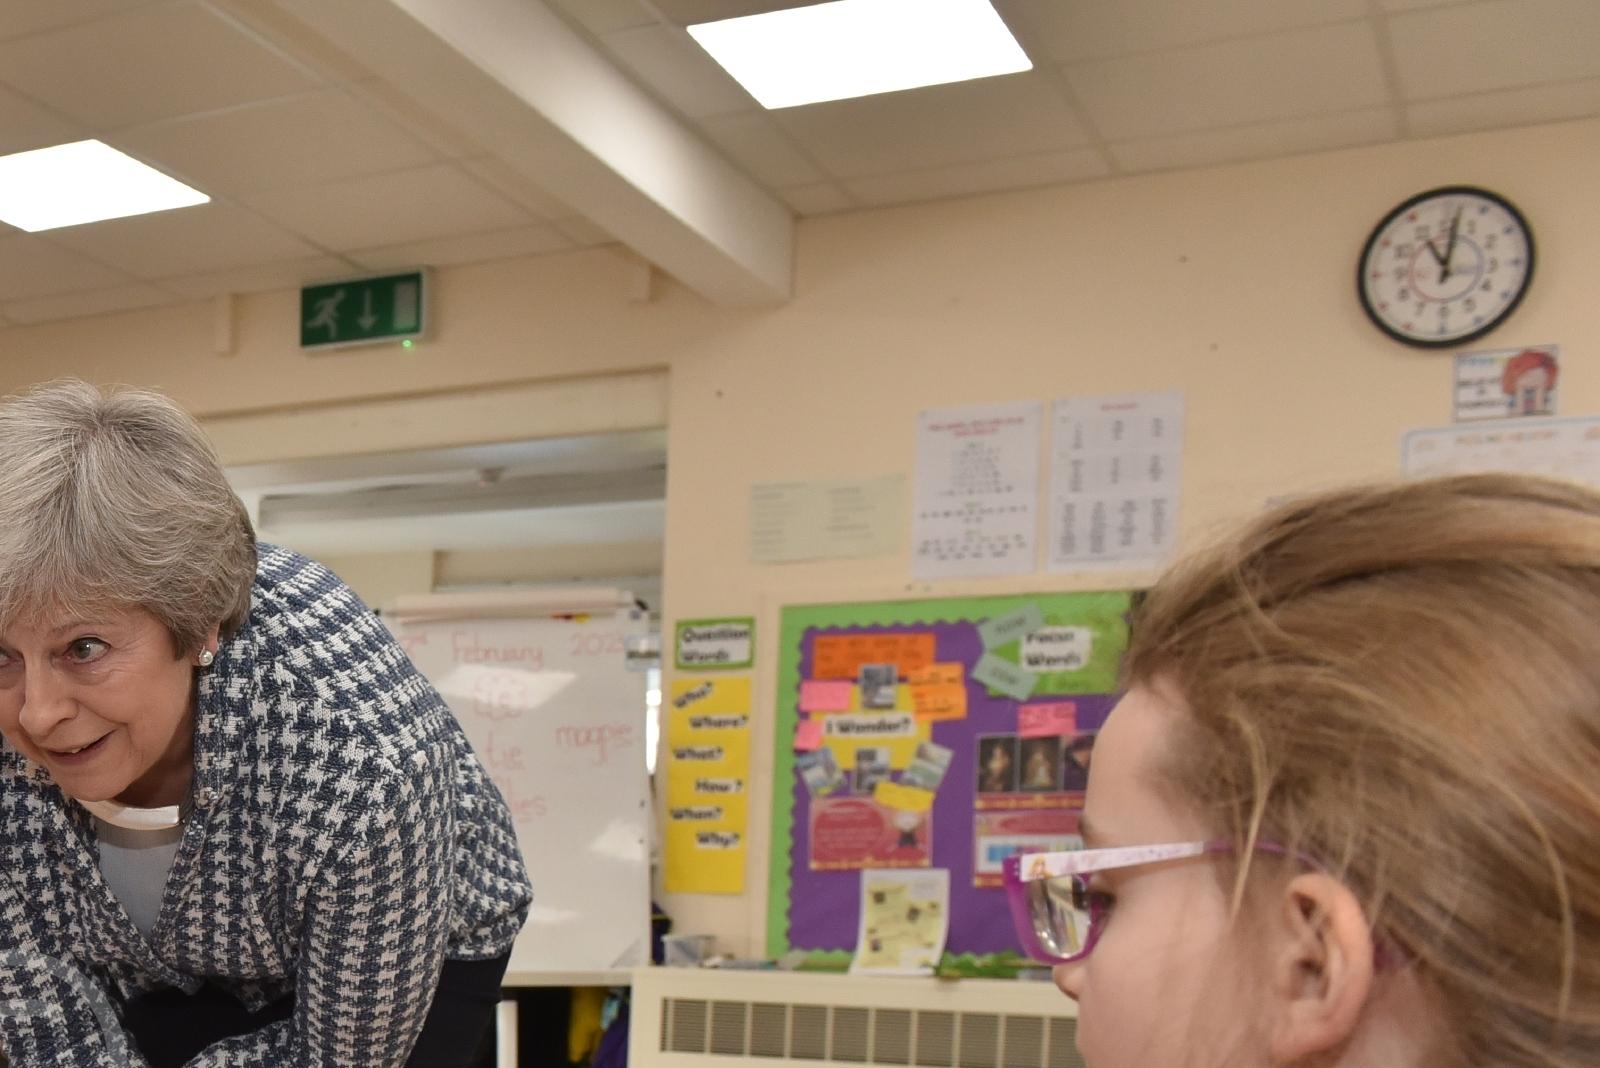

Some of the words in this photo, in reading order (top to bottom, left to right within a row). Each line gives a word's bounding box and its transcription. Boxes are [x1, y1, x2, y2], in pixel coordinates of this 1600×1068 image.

[683, 628, 749, 642] Question
[451, 632, 544, 672] February
[689, 715, 748, 729] Where?
[838, 716, 911, 733] Wonder?
[556, 722, 634, 766] magpie
[673, 746, 723, 760] What?
[696, 831, 740, 848] Why?
